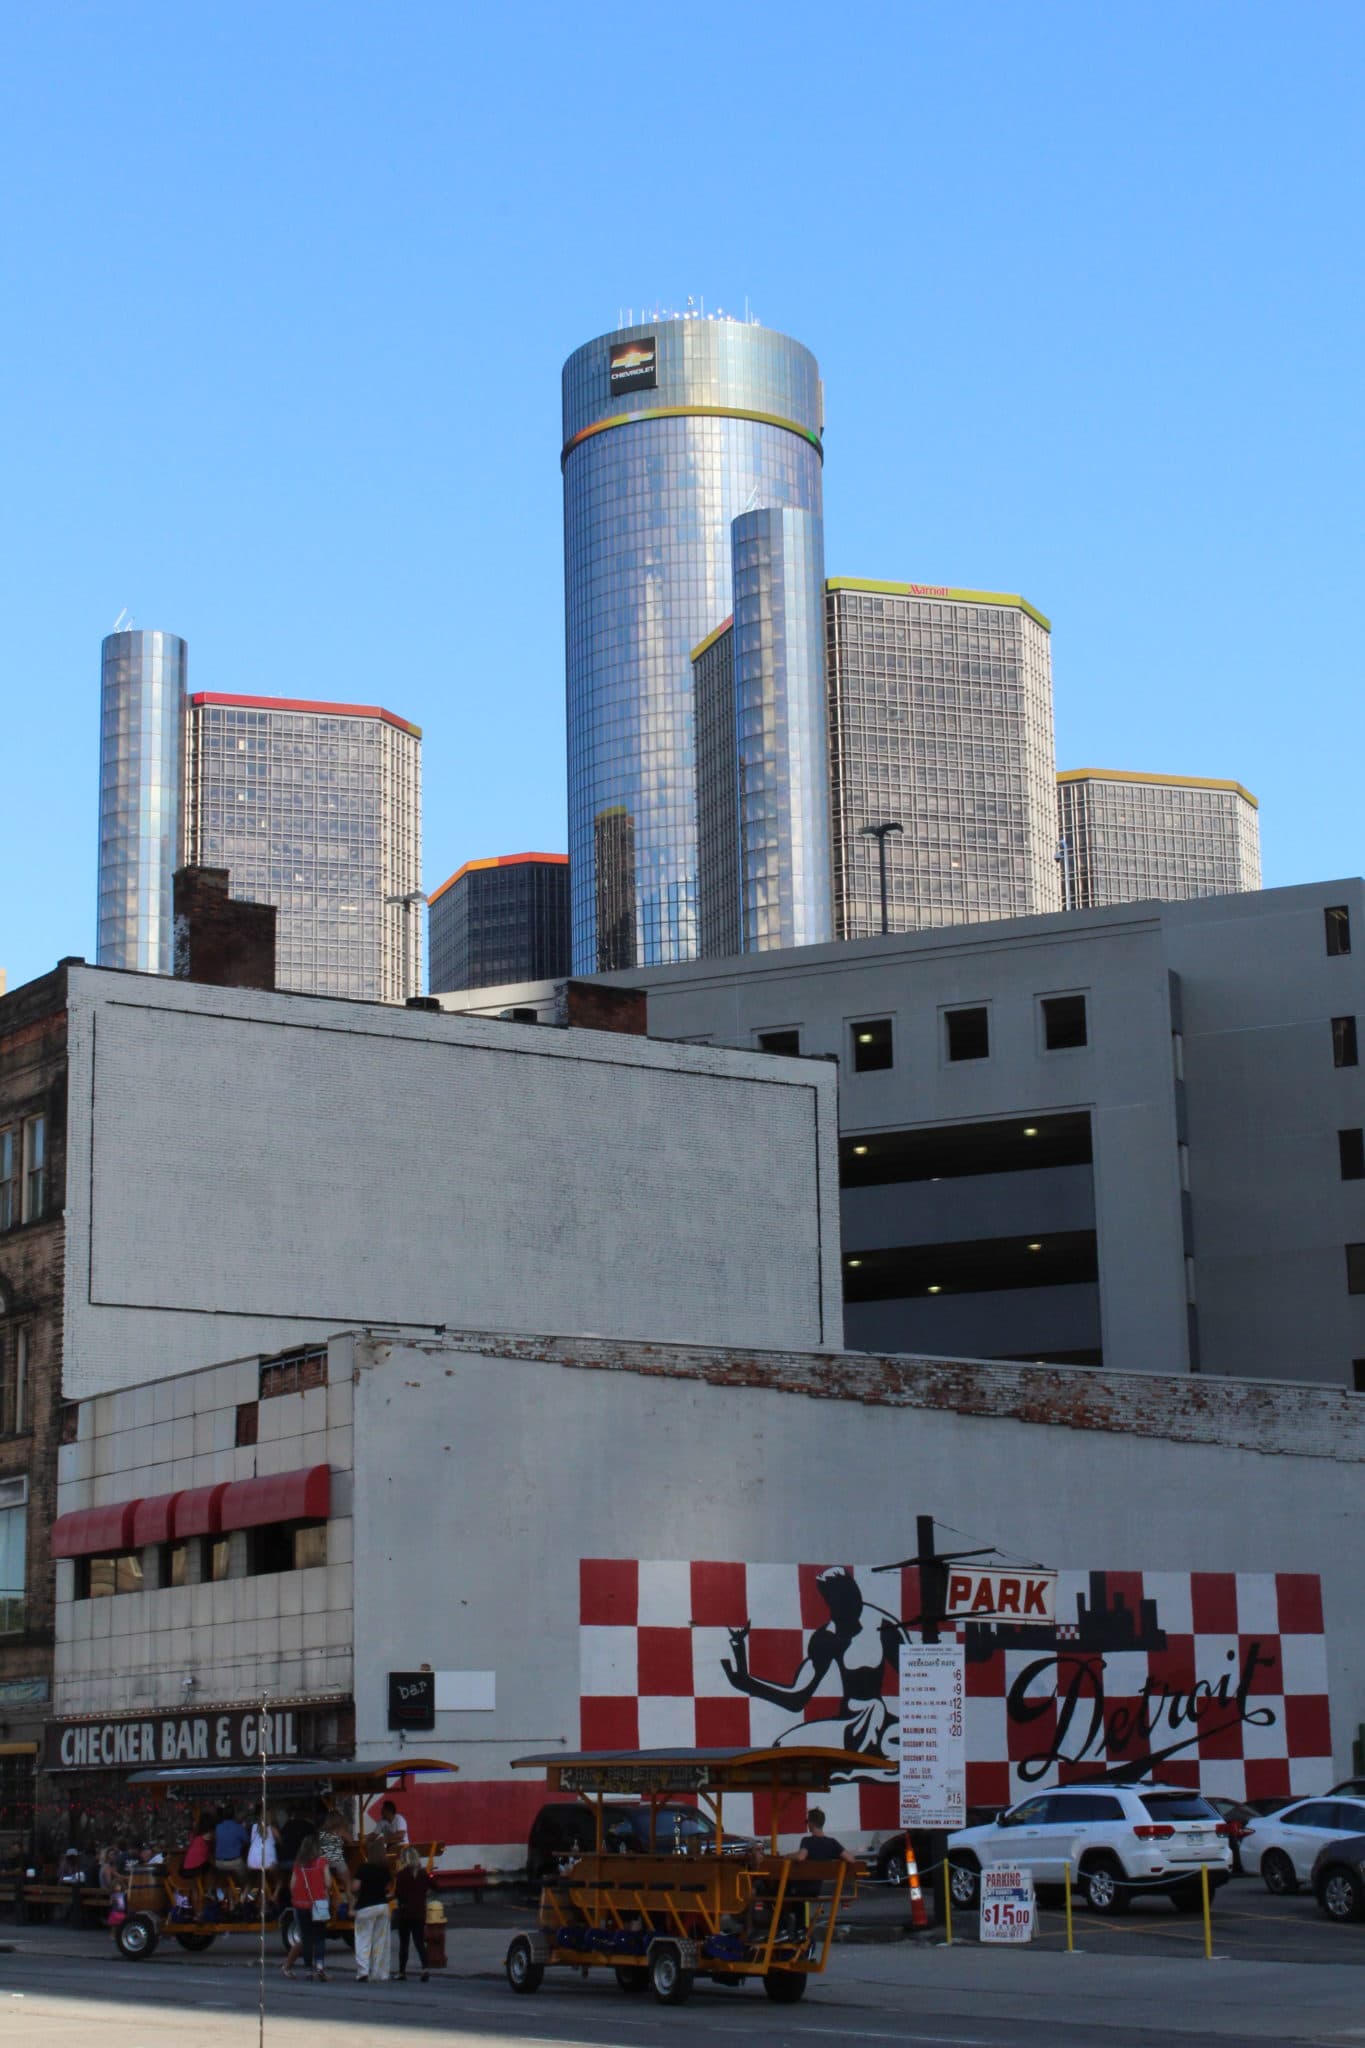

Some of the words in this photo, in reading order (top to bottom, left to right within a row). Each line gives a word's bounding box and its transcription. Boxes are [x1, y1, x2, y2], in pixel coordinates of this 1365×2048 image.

[611, 366, 655, 380] CHEVROLET
[908, 584, 950, 597] Marriott
[948, 1575, 1049, 1615] PARK
[397, 1681, 427, 1700] bar
[1007, 1642, 1276, 1783] Detroit
[60, 1722, 155, 1766] CHECKER
[160, 1718, 208, 1761] BAR
[215, 1716, 231, 1758] &
[240, 1712, 297, 1758] GRIL
[986, 1872, 1021, 1887] PARKING
